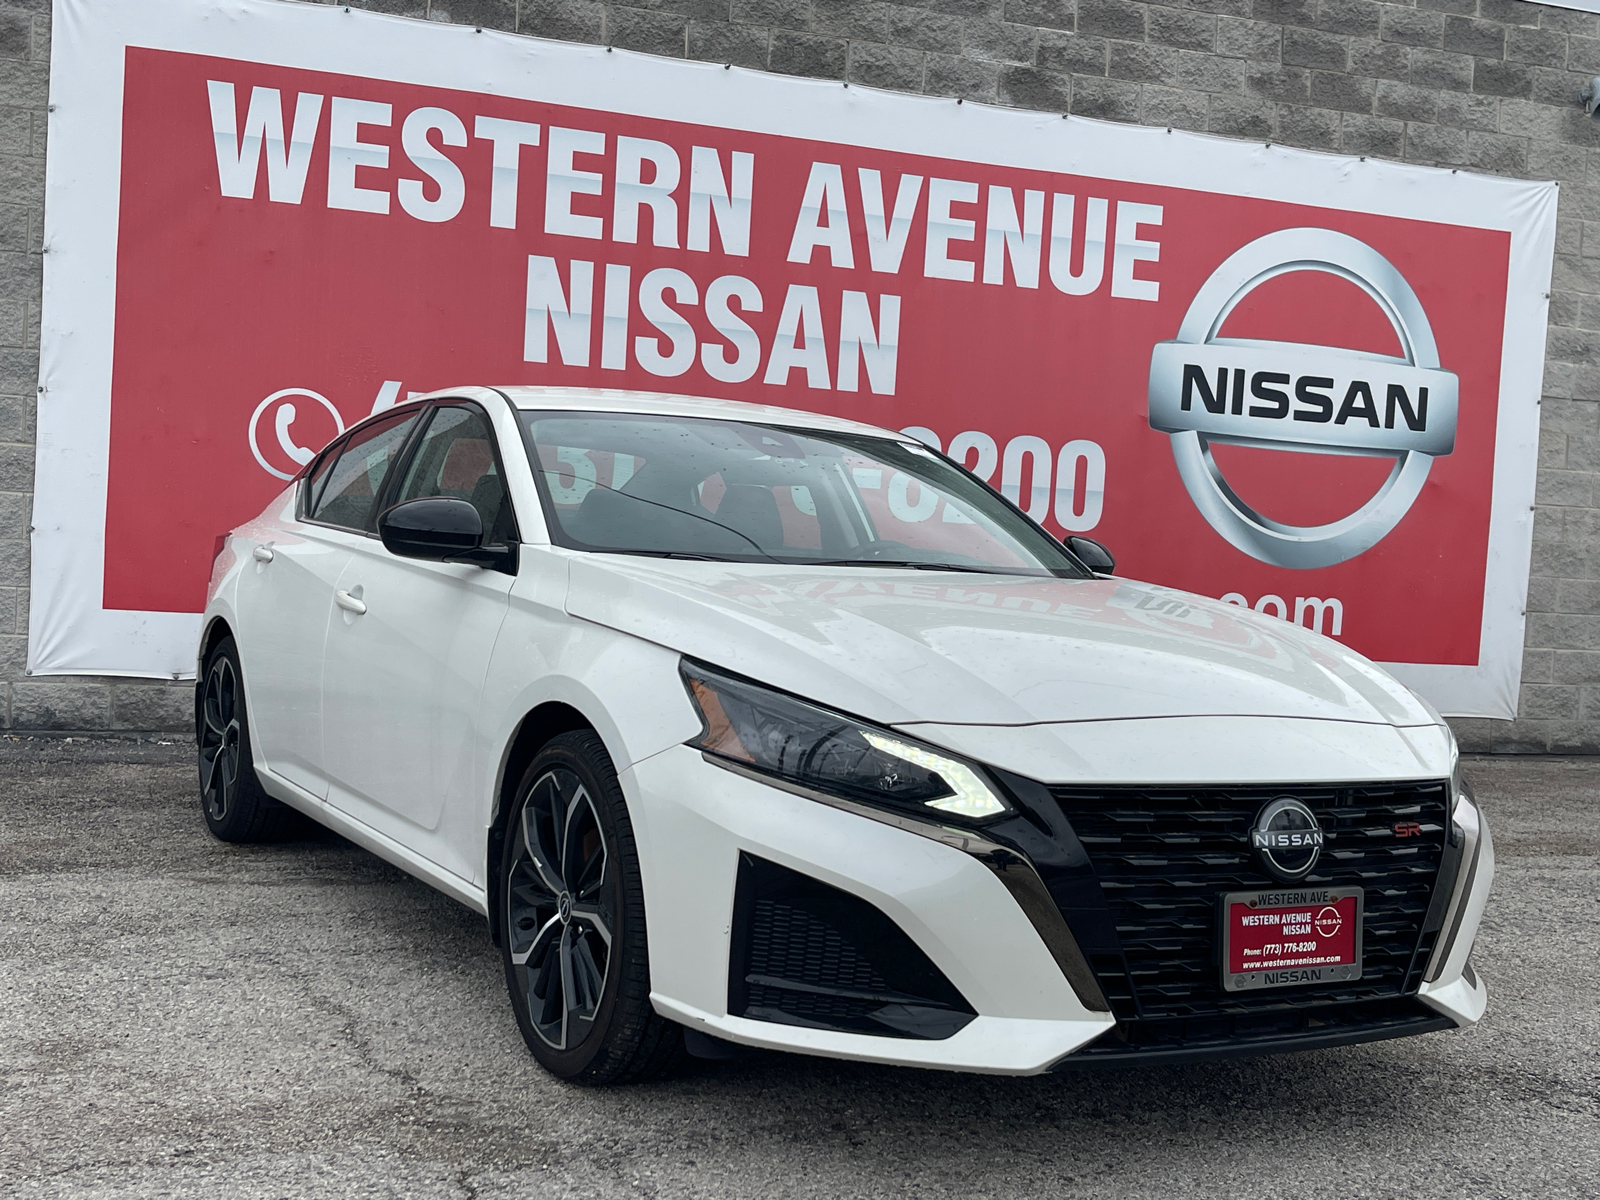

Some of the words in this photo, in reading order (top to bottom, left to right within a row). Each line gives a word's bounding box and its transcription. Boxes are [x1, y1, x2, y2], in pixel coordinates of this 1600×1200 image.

[206, 79, 754, 257] WESTERN
[787, 161, 1164, 302] AVENUE
[523, 255, 902, 396] NISSAN
[1180, 364, 1428, 432] NISSAN
[1395, 823, 1421, 837] SR
[1255, 832, 1323, 847] NISSAN
[1258, 893, 1307, 906] WESTERN
[1242, 914, 1280, 926] WESTERN
[1281, 913, 1312, 924] AVENUE
[1283, 924, 1311, 935] NISSAN
[1243, 948, 1262, 956] Phone:
[1263, 943, 1282, 957] (773)
[1283, 941, 1317, 953] 776-8200
[1242, 955, 1341, 969] www.westernavenissan.com
[1264, 969, 1322, 985] NISSAN
